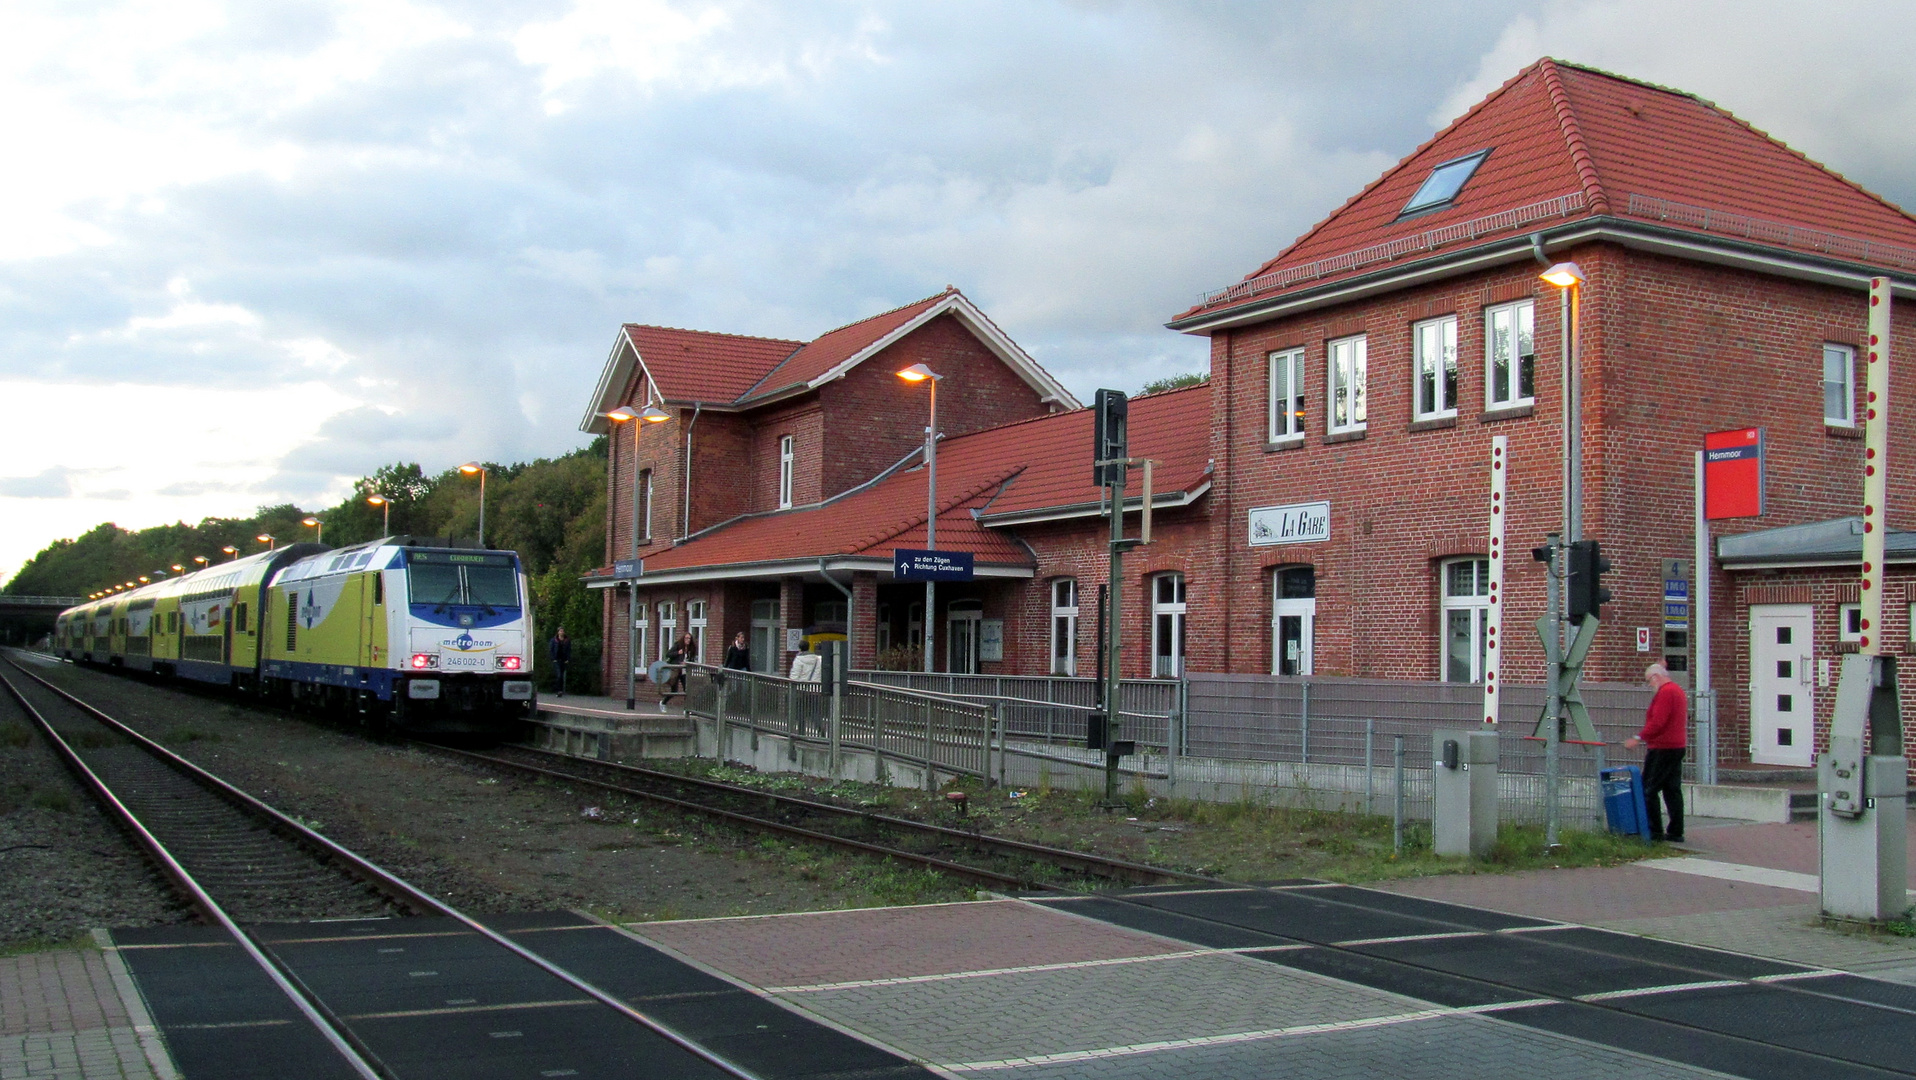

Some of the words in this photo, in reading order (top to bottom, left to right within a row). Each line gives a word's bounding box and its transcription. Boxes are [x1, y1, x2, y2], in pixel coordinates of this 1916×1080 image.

[1709, 450, 1742, 460] Hemmoor
[934, 557, 951, 565] Zügen
[1671, 562, 1679, 577] 4
[443, 638, 493, 647] metronom
[463, 657, 486, 666] 002-0
